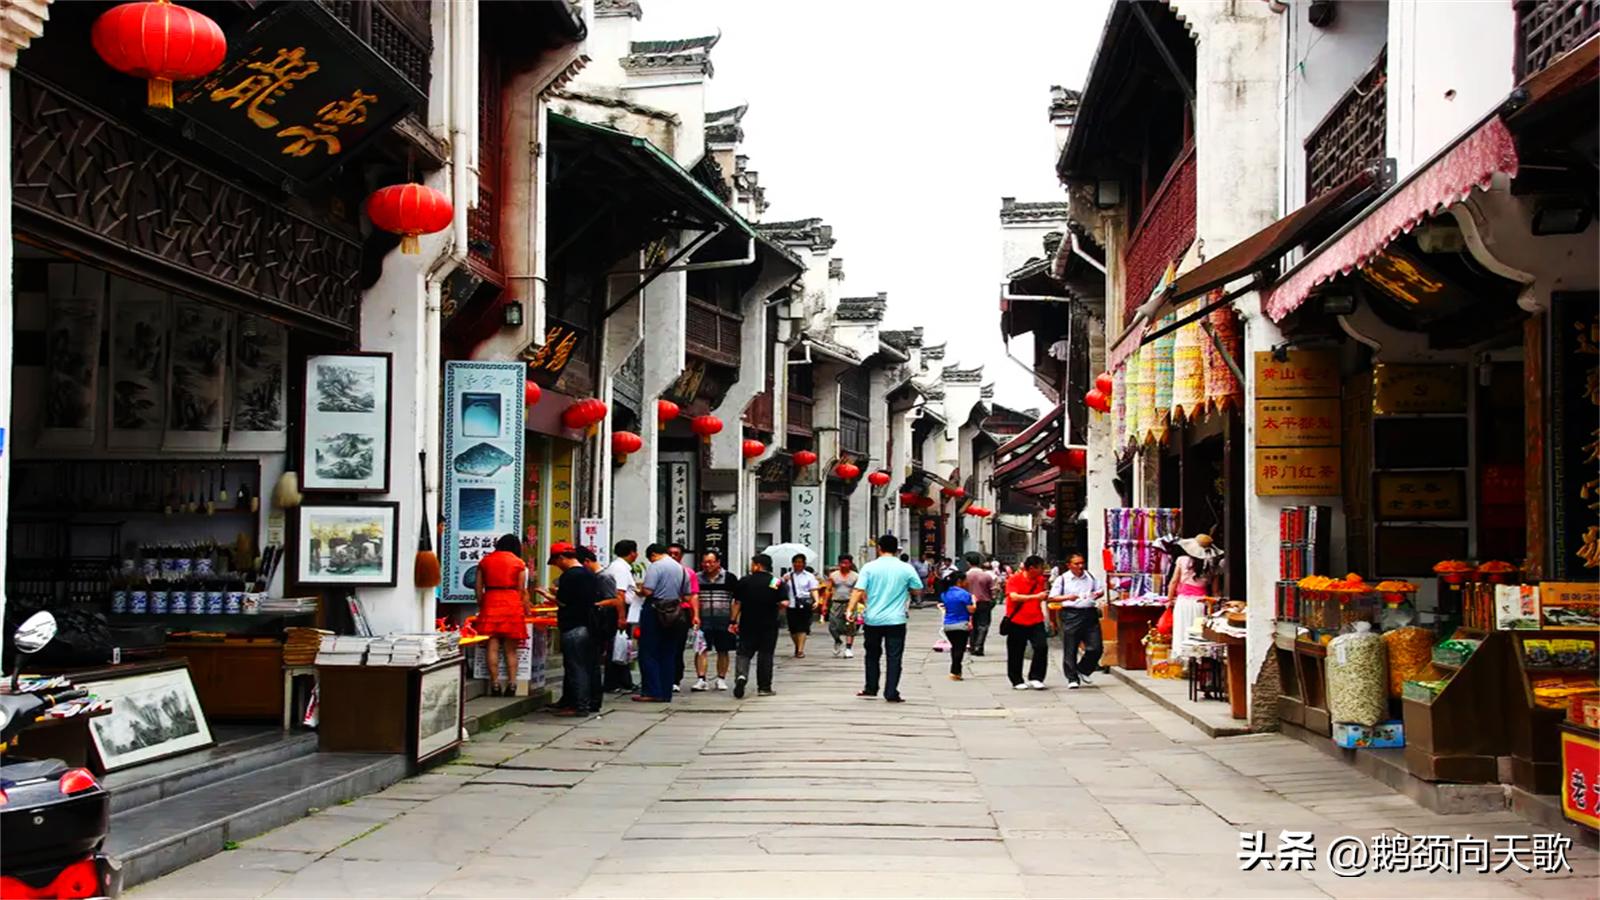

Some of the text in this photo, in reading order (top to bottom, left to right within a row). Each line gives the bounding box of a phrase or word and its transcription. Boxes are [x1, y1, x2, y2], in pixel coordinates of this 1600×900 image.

[1262, 367, 1332, 381] 黄山毛
[1261, 464, 1335, 480] 祁门红茶
